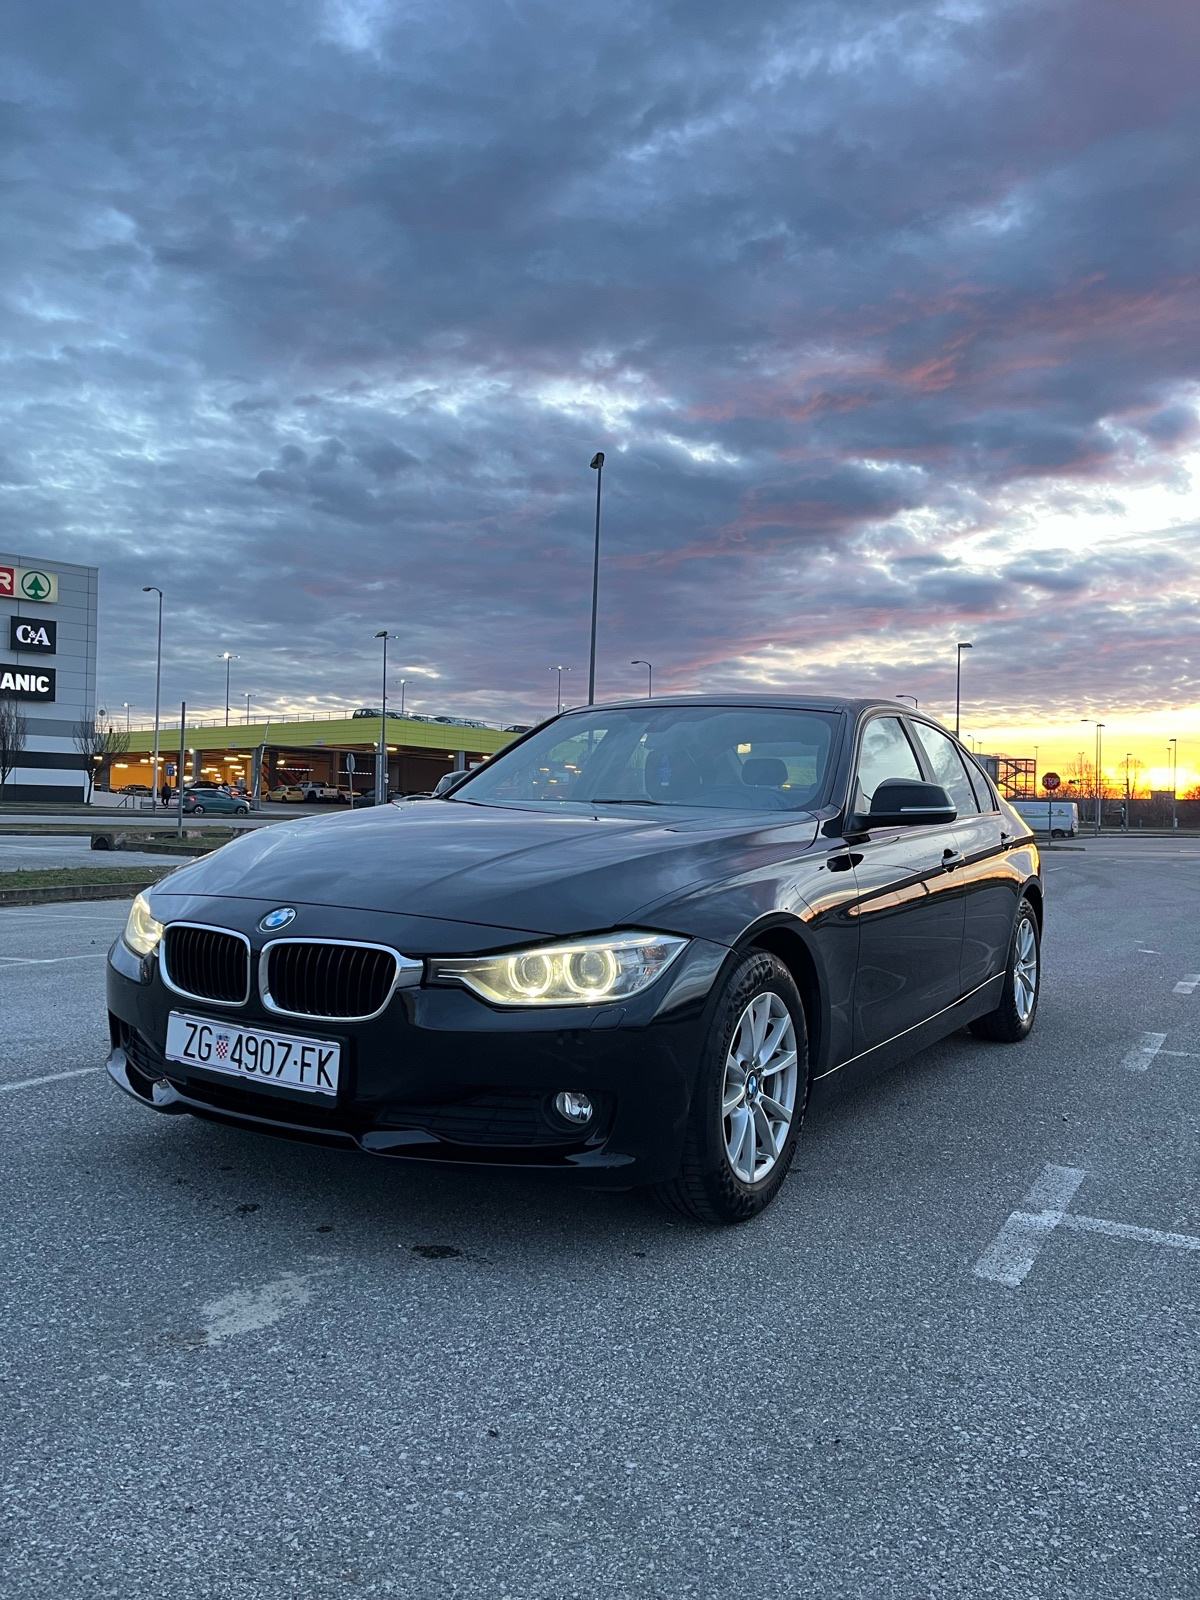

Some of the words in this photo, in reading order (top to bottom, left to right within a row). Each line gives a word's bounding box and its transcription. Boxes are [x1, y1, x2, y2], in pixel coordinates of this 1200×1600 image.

[16, 625, 51, 646] C&A
[1043, 777, 1059, 786] STOP
[183, 1022, 213, 1061] ZG
